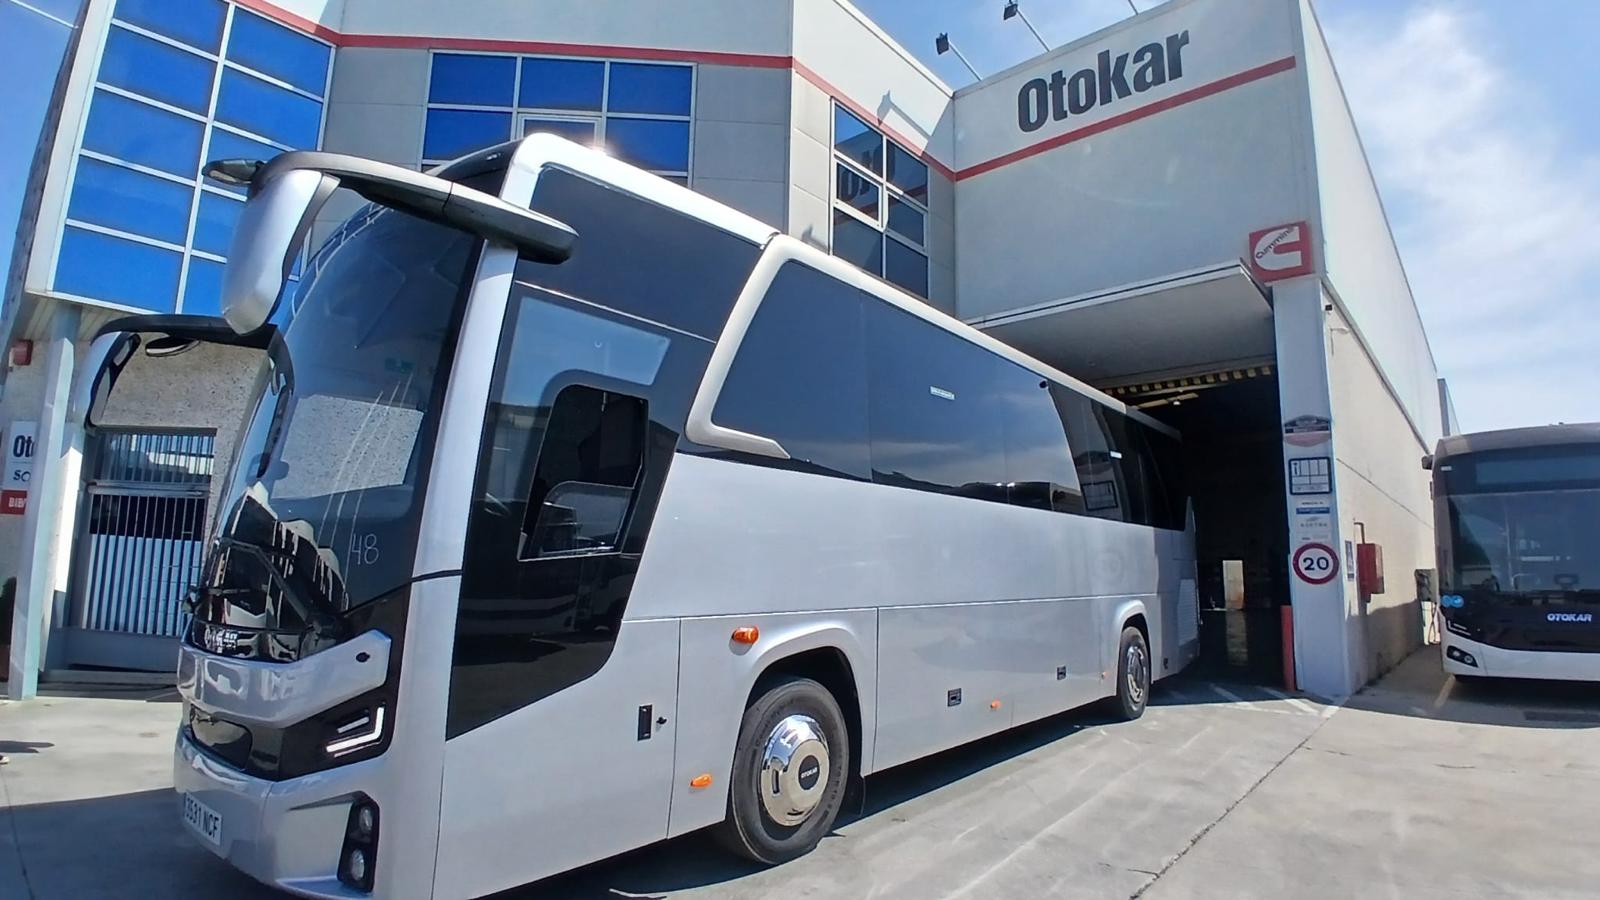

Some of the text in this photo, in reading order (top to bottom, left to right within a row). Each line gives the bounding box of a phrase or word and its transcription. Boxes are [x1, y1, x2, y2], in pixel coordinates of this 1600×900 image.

[1018, 30, 1190, 133] Otokar
[351, 533, 379, 565] 48
[1303, 556, 1329, 571] 20
[1547, 613, 1592, 622] OTOKAR
[203, 810, 219, 840] NCF
